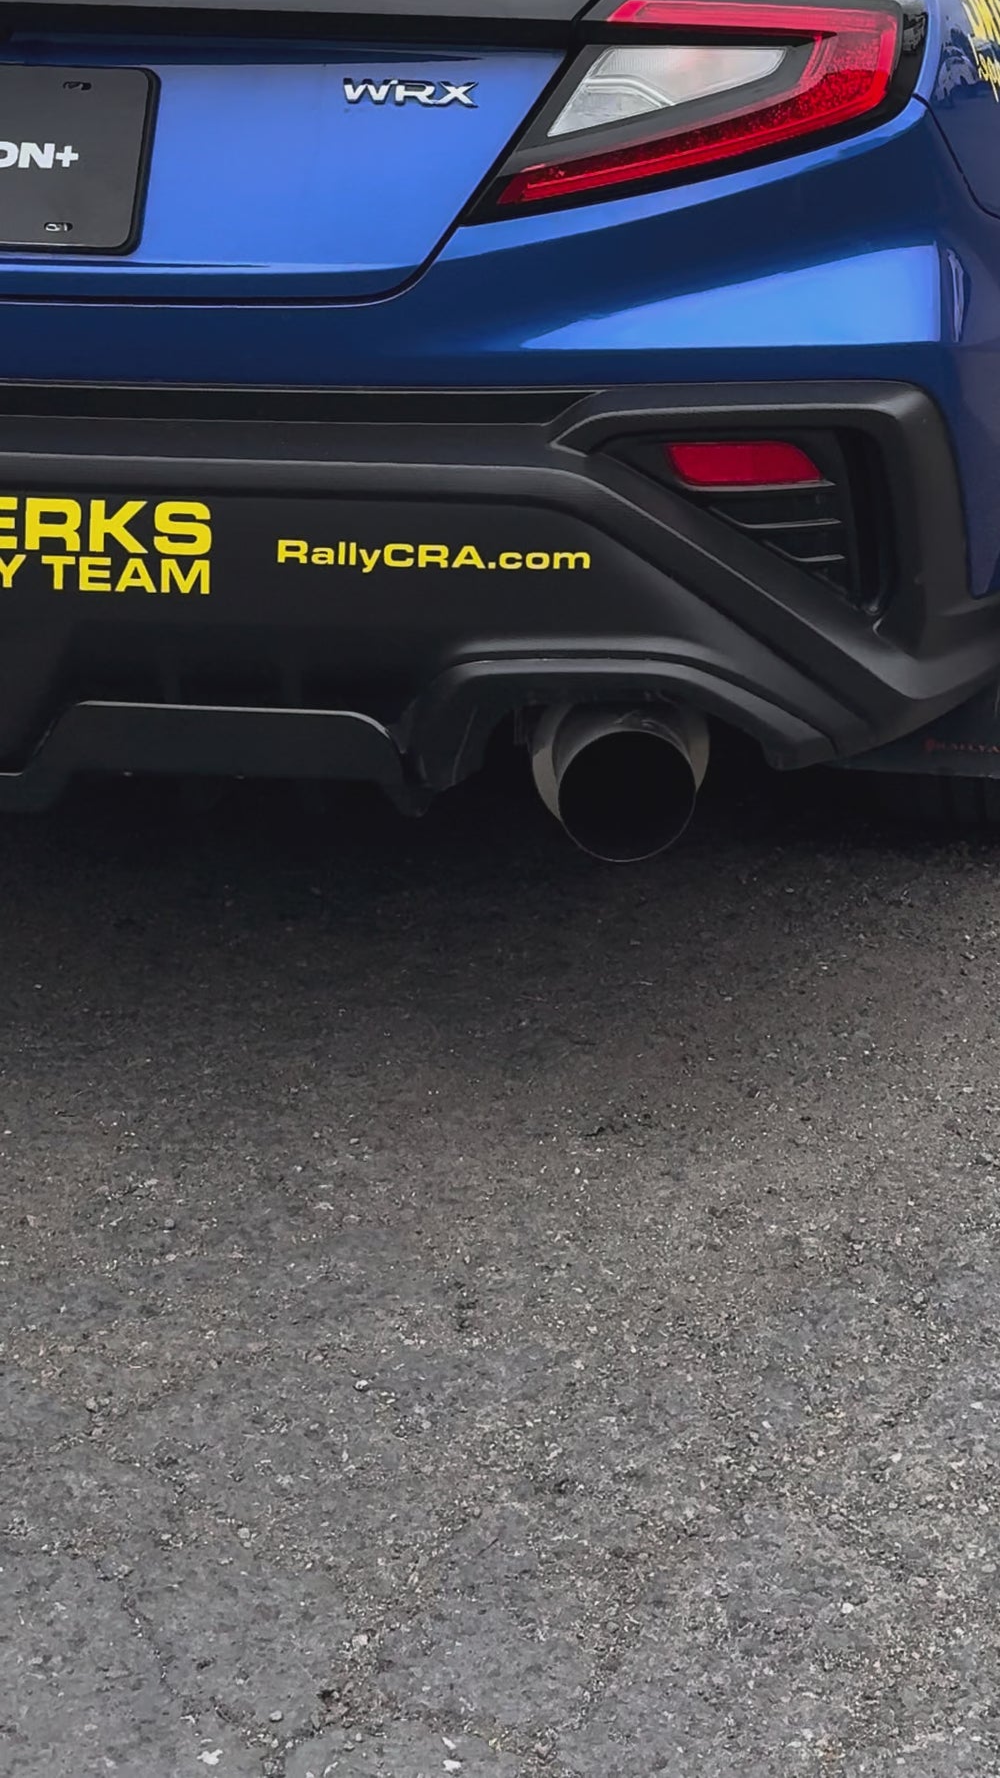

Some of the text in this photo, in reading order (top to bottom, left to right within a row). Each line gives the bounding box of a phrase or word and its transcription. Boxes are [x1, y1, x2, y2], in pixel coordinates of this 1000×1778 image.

[343, 77, 480, 108] WRX
[277, 539, 591, 573] RallyCRA.com
[41, 555, 210, 594] TEAM
